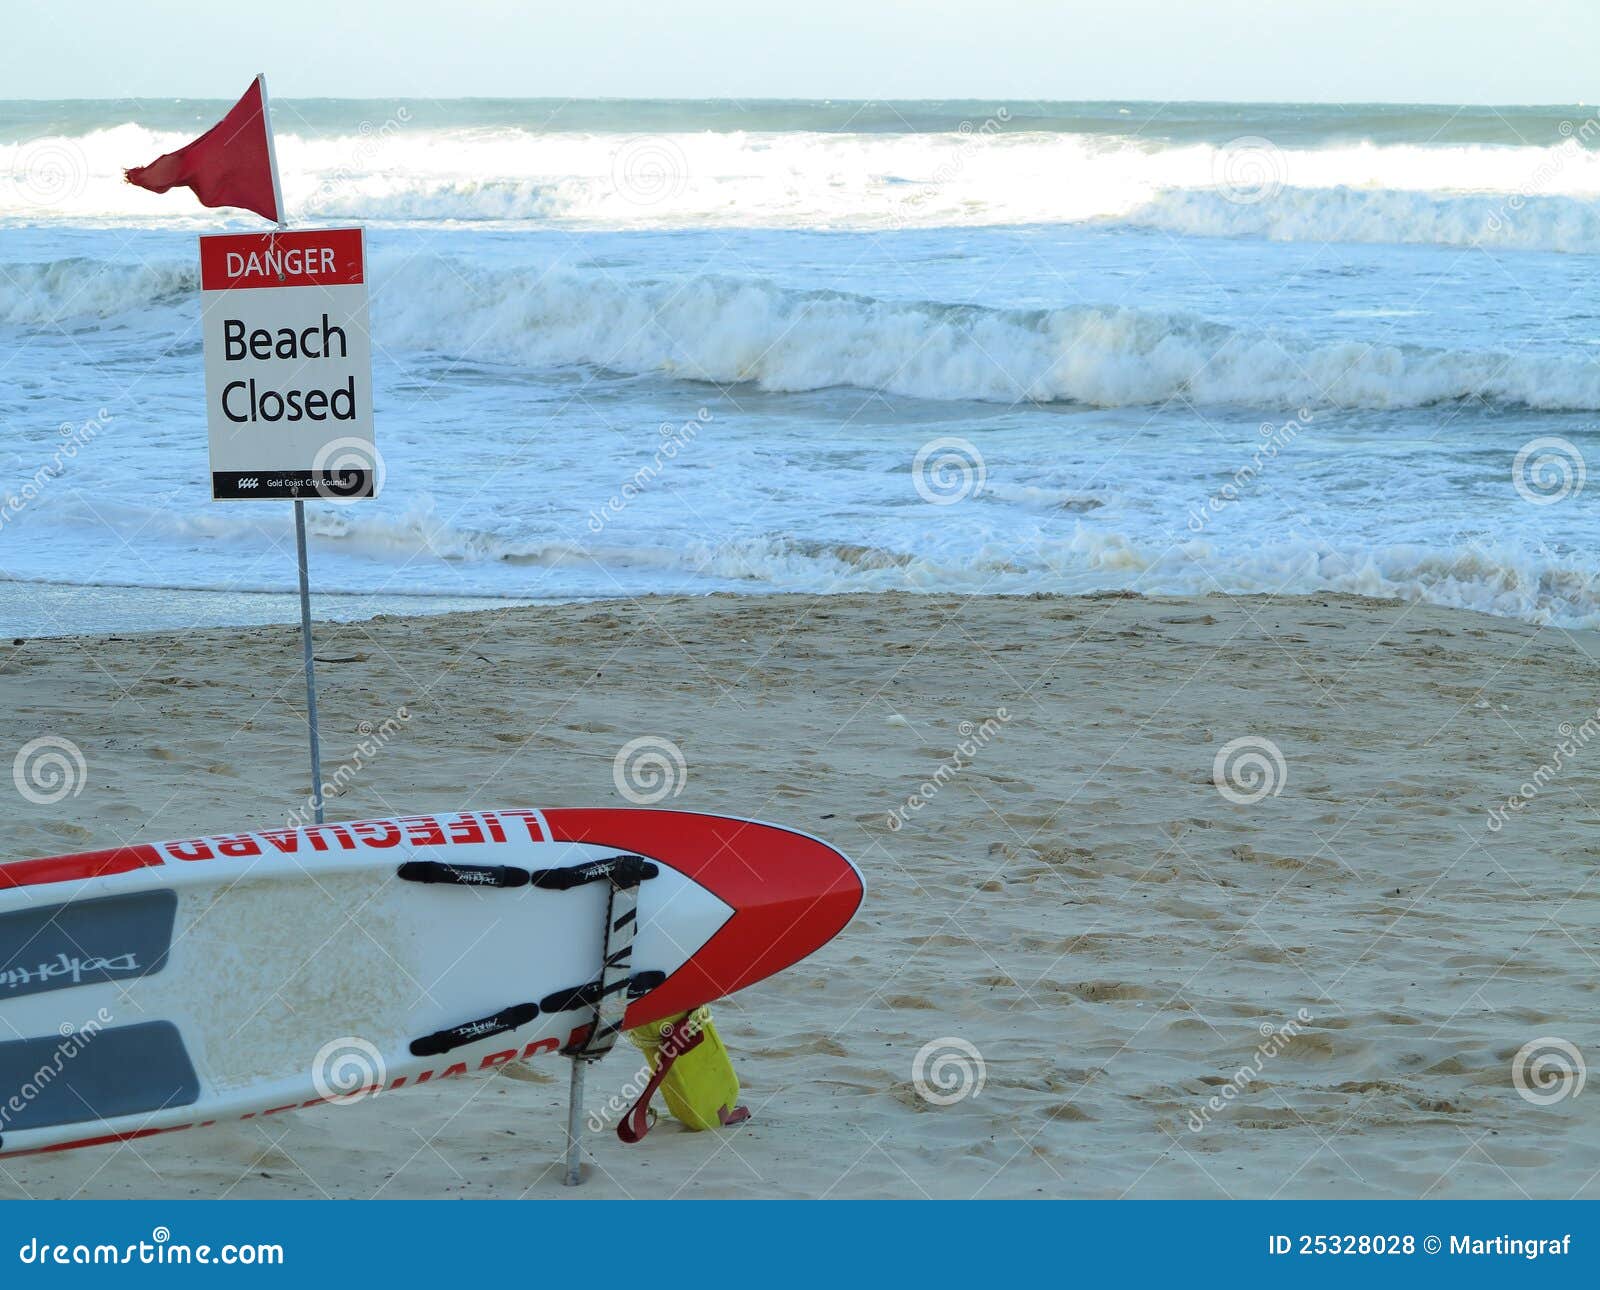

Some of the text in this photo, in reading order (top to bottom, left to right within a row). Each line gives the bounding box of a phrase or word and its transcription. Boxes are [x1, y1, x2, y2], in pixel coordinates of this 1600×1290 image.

[226, 247, 337, 279] DANGER
[223, 313, 347, 361] Beach
[221, 375, 356, 423] Closed
[266, 478, 347, 488] Gold Coast City Council
[165, 810, 546, 861] LIFEGUARD
